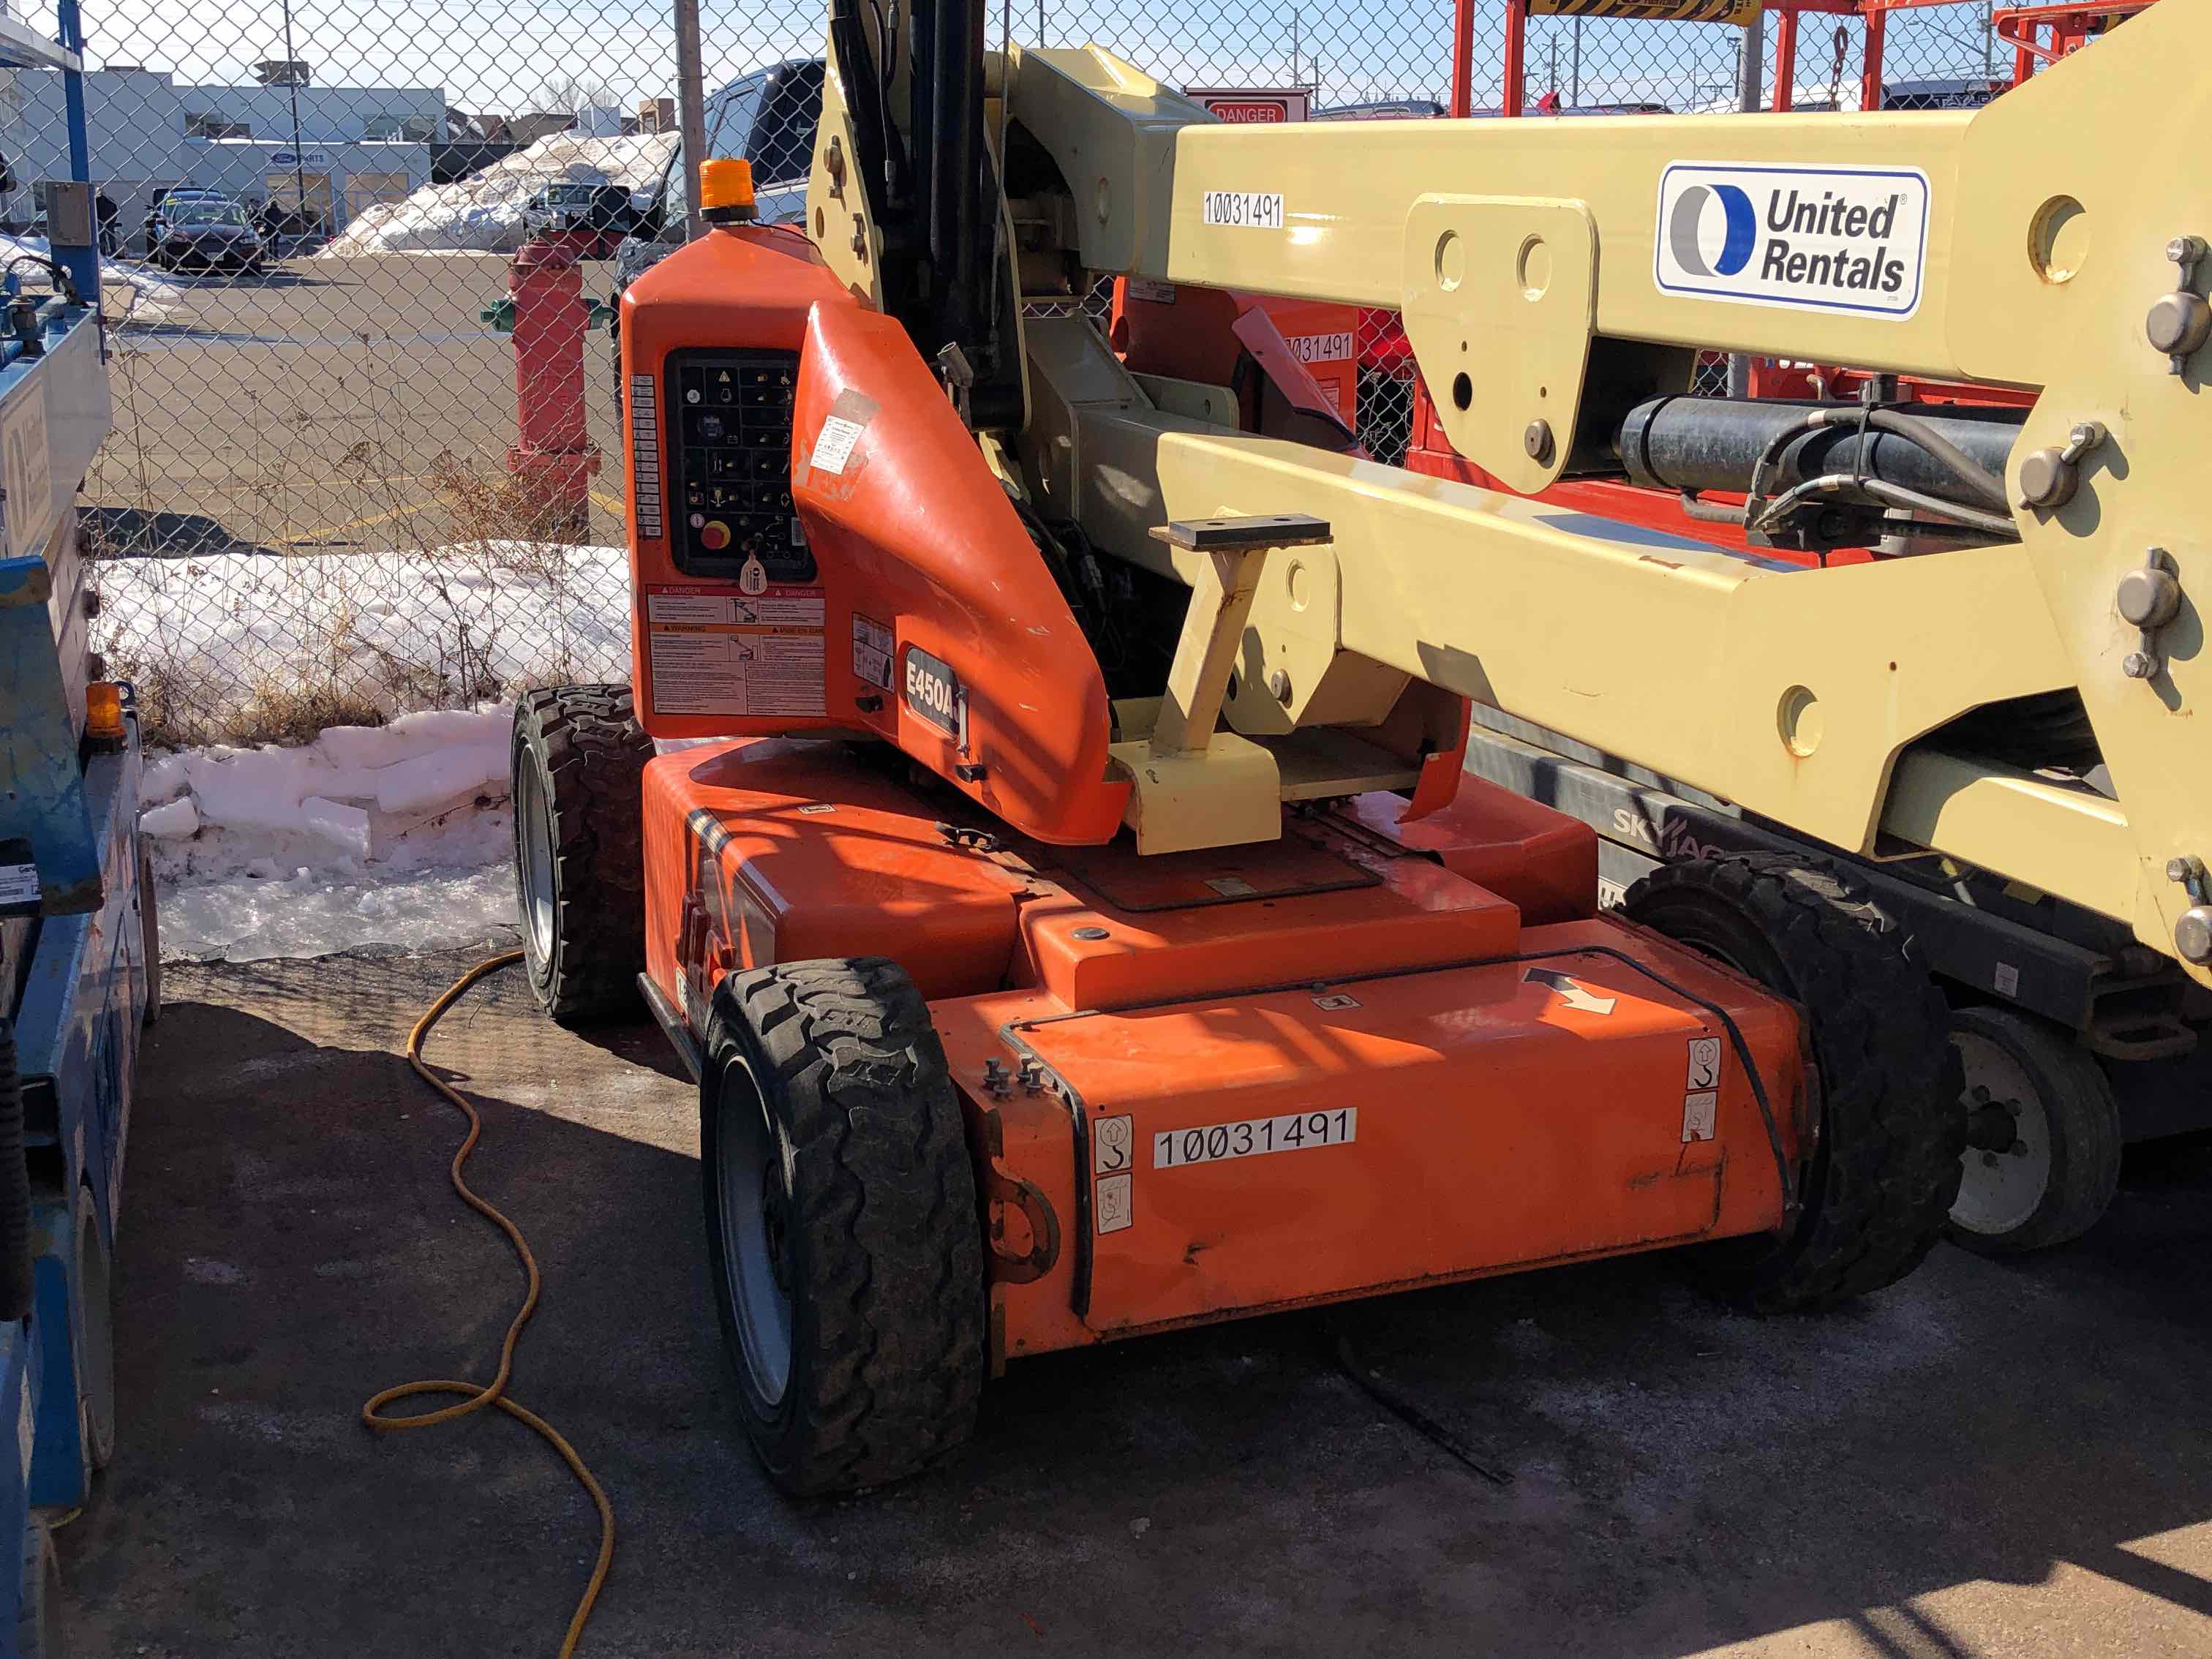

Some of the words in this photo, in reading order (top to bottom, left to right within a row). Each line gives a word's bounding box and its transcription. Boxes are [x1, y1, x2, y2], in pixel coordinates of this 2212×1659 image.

[1216, 108, 1276, 122] DANGER
[1205, 192, 1280, 227] 10031491
[1767, 189, 1899, 239] United
[1761, 238, 1905, 293] Rentals
[1287, 333, 1350, 362] 031491
[1159, 1110, 1348, 1165] 10031491
